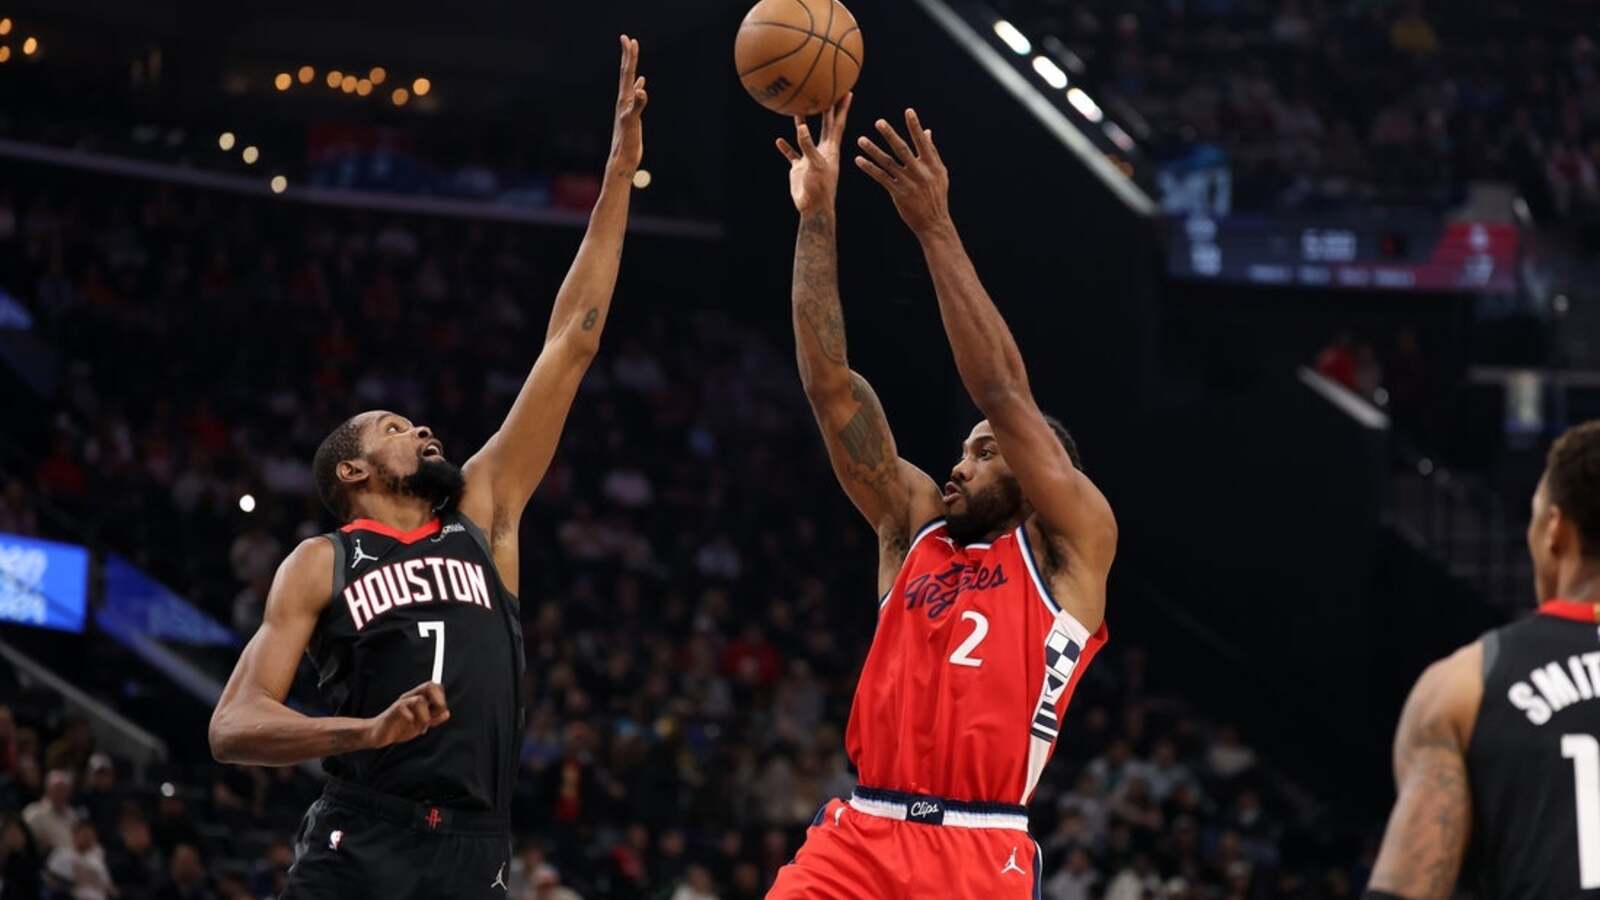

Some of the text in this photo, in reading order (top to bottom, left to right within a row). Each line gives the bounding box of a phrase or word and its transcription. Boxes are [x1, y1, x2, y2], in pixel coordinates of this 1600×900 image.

[343, 556, 493, 632] HOUSTON
[904, 563, 1008, 619] Anges
[417, 620, 445, 685] 7
[949, 610, 989, 667] 2
[1507, 651, 1600, 726] SMIT
[910, 801, 940, 818] Clips
[1560, 733, 1600, 889] 1
